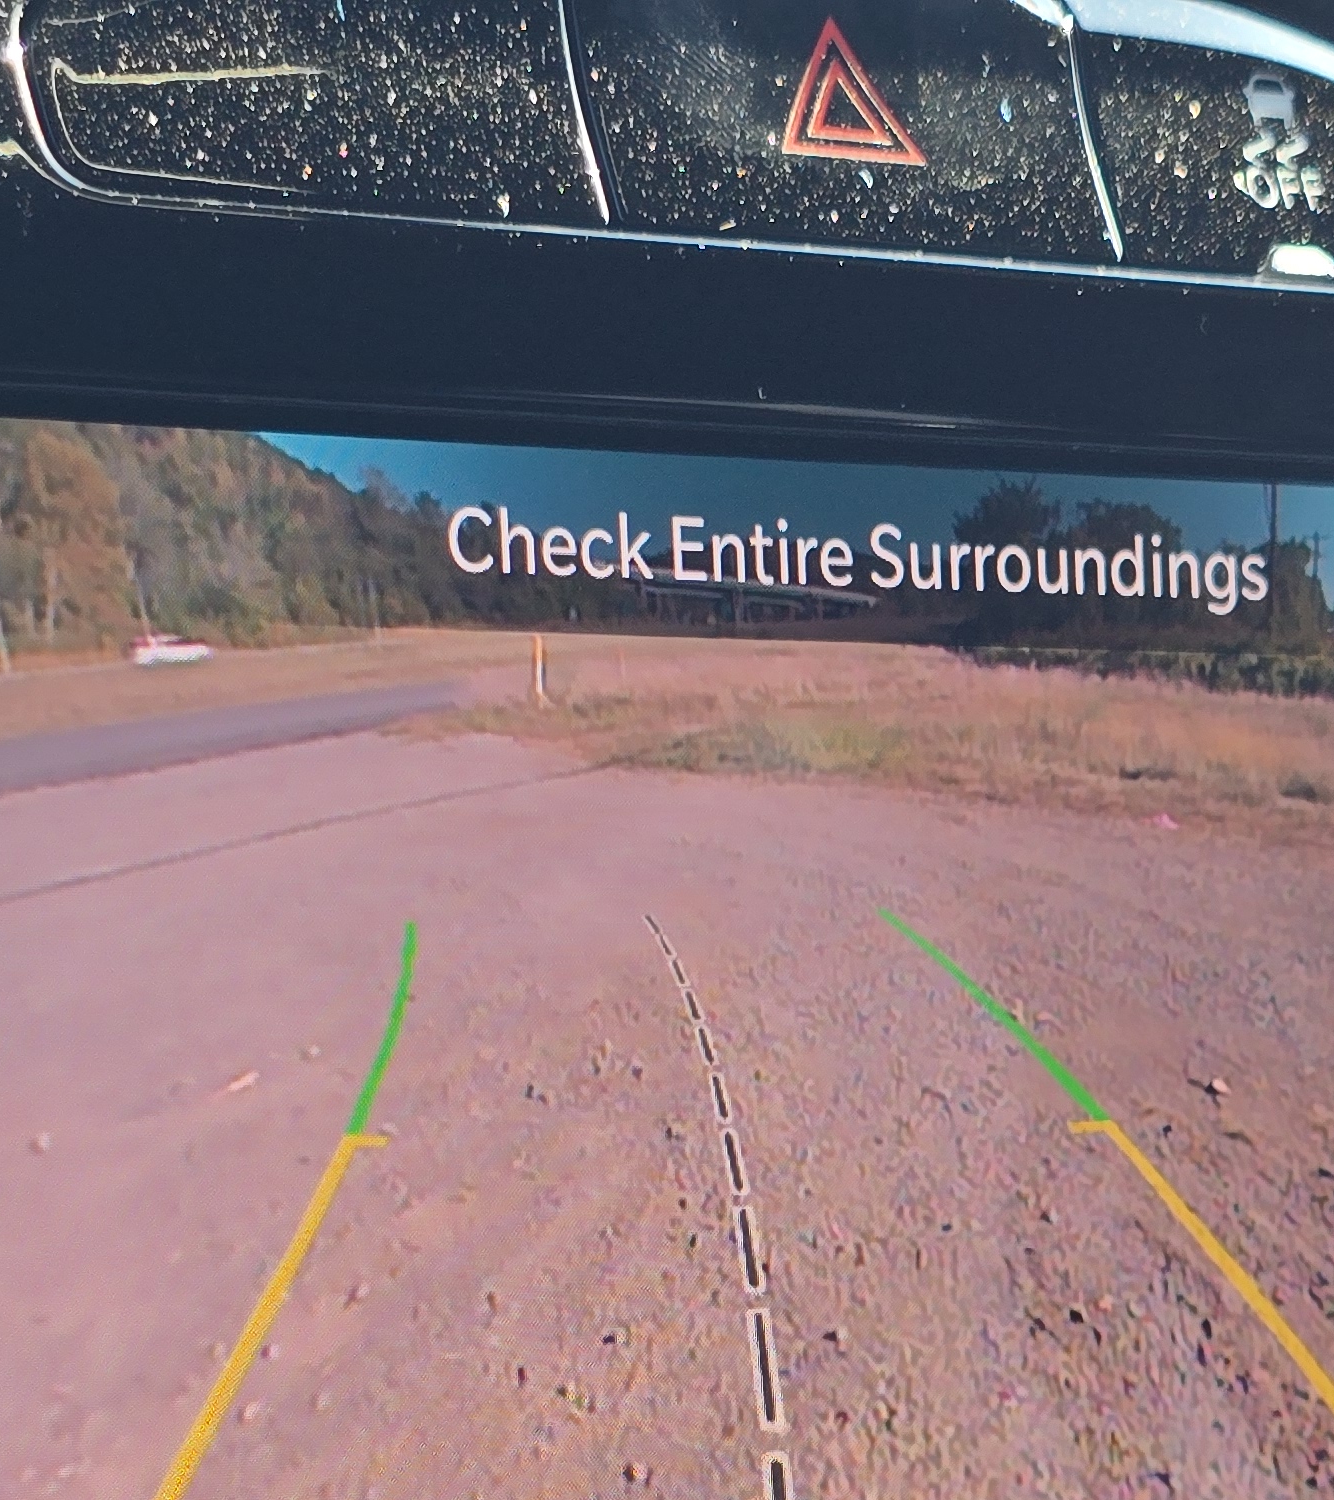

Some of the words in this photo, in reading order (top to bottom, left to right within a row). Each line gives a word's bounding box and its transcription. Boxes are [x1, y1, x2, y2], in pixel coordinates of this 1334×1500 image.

[448, 506, 654, 582] Check
[670, 516, 854, 588] Entire
[870, 523, 1268, 617] Surroundings
